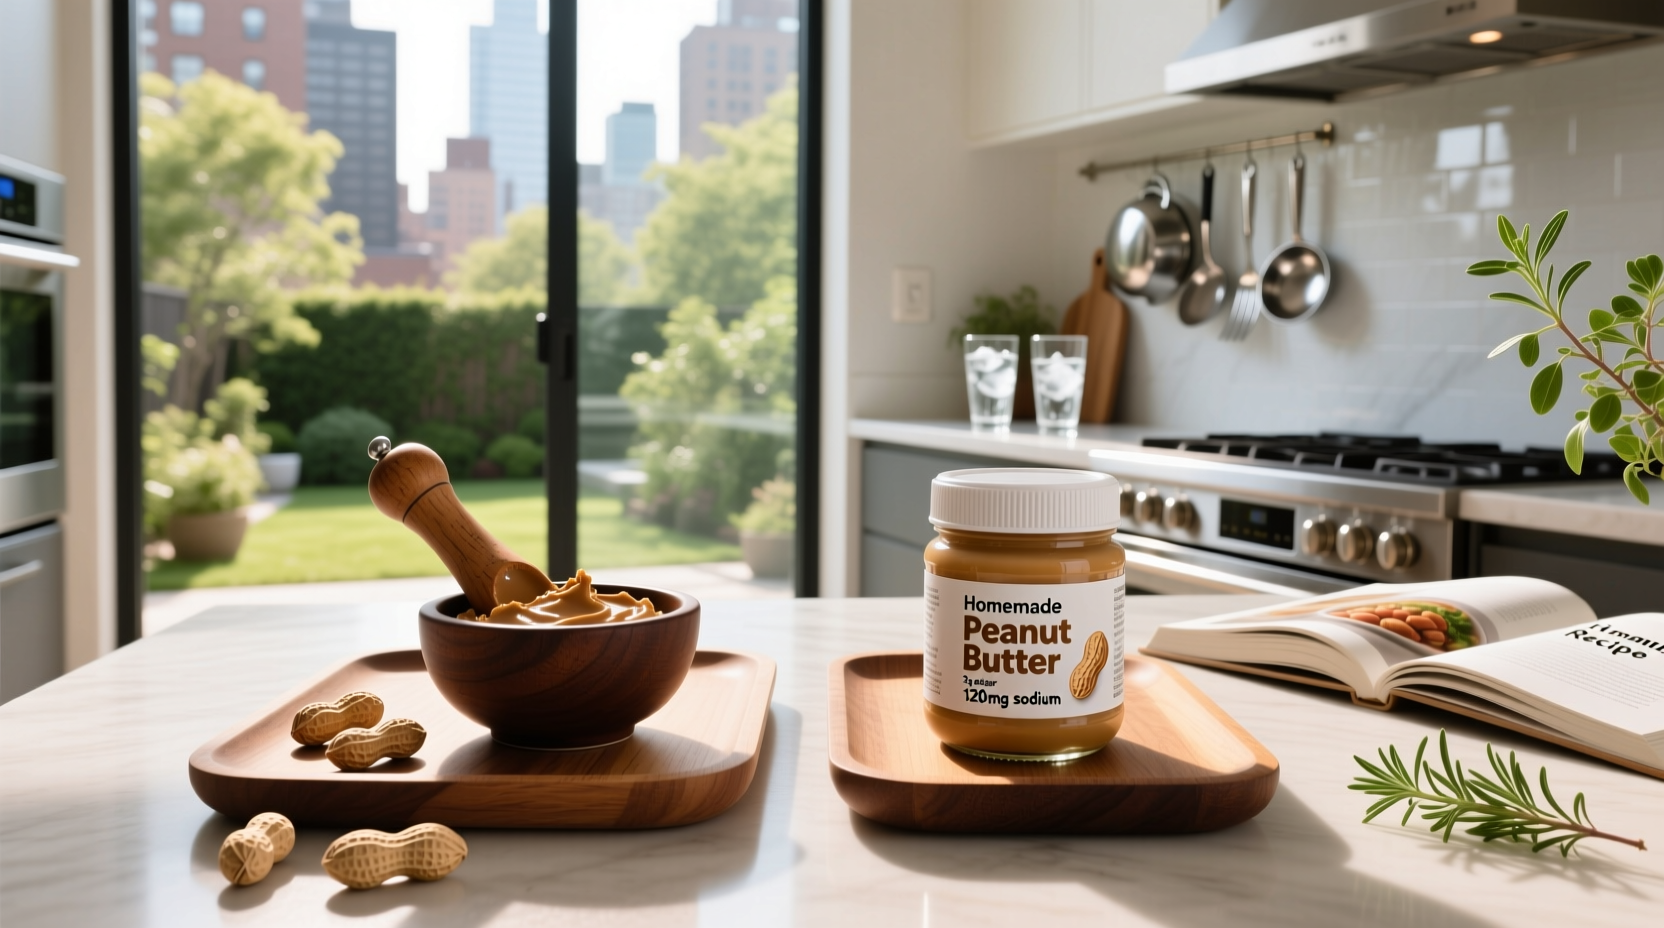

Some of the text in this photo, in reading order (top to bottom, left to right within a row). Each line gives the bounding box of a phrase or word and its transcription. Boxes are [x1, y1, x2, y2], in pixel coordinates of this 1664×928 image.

[964, 595, 1062, 614] Homemade
[964, 615, 1072, 645] Peanut
[963, 643, 1061, 675] Butter
[963, 688, 1061, 709] 120mg sodium
